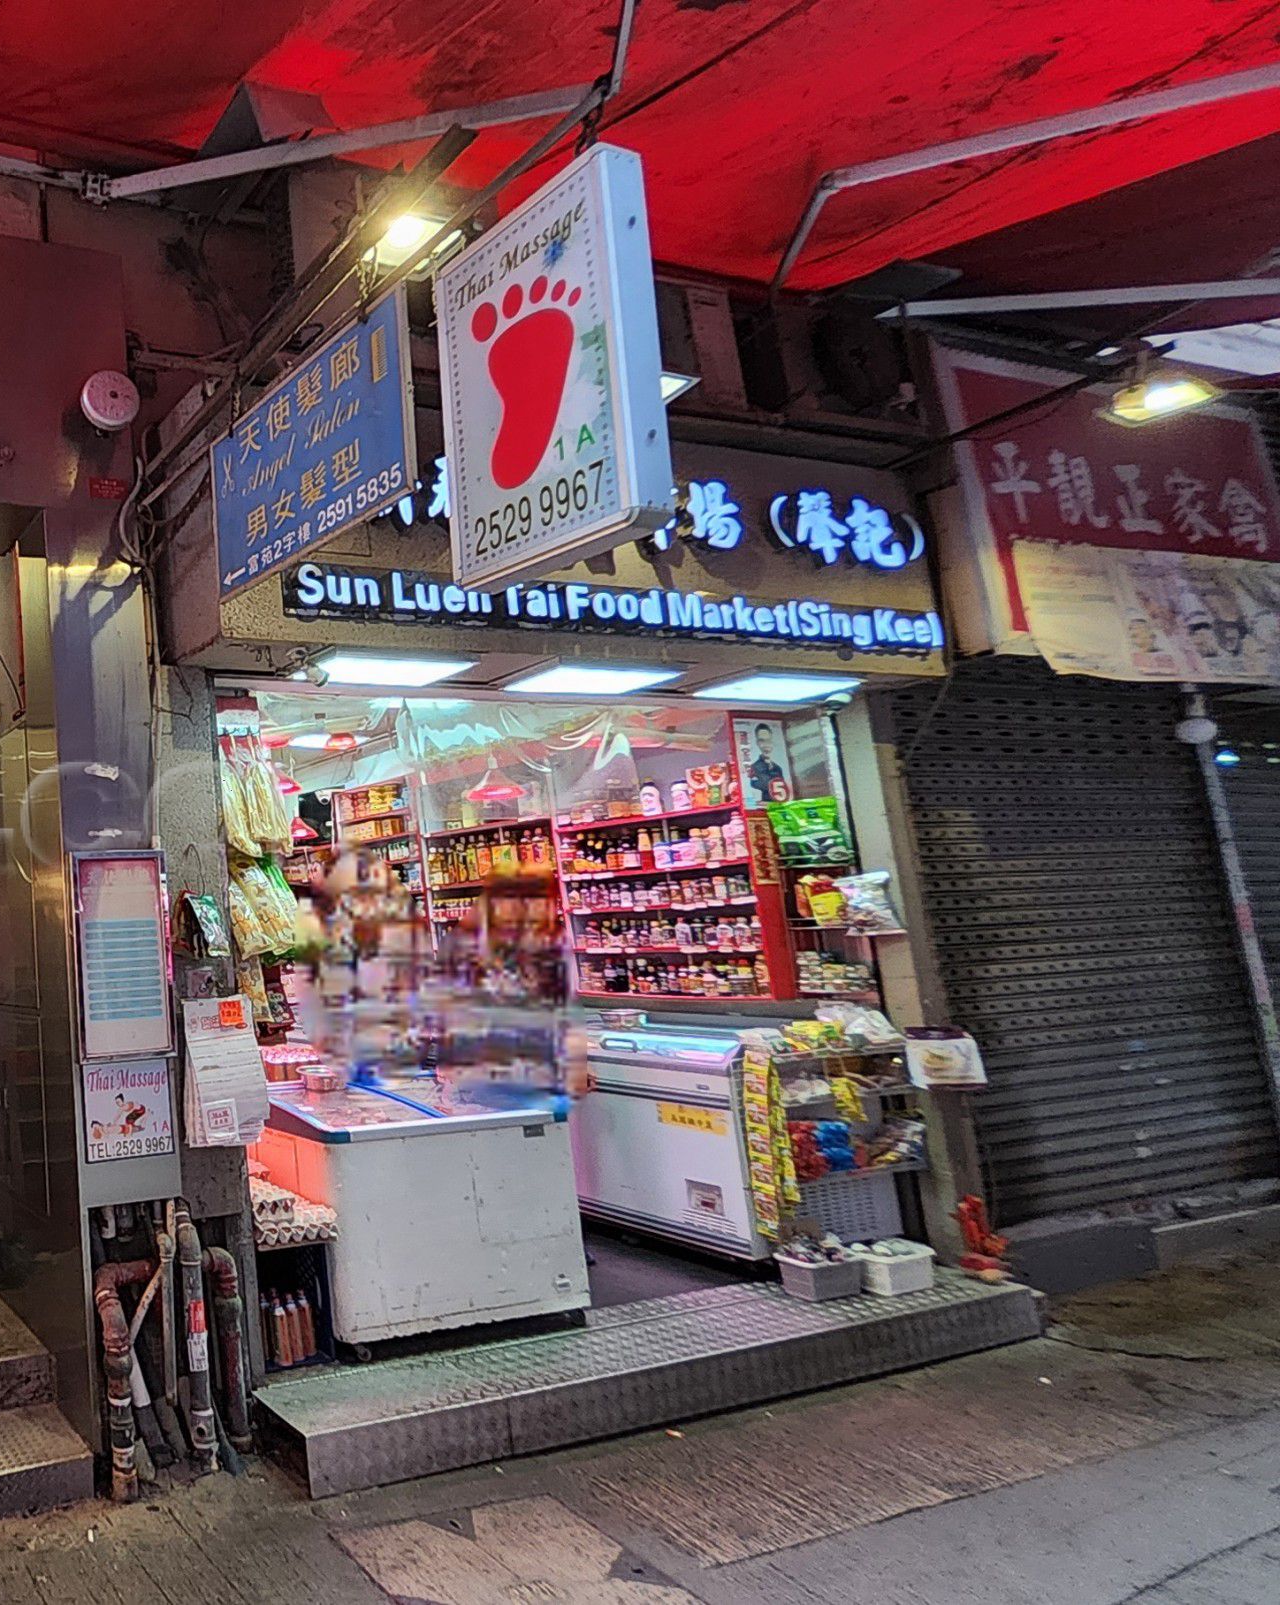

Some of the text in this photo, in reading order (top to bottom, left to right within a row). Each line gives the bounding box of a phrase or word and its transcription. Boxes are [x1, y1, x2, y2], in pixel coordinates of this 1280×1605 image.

[455, 197, 586, 311] Thai Massage
[238, 335, 360, 464] 天使髮廊
[242, 433, 297, 496] Angel
[246, 438, 363, 546] 男女髮型
[473, 495, 532, 557] 2529
[540, 459, 606, 528] 9967
[297, 564, 381, 607] Sun
[392, 571, 493, 615] Luen
[566, 584, 662, 627] Food
[87, 1068, 167, 1095] Thai Massage
[145, 1136, 173, 1153] 9967
